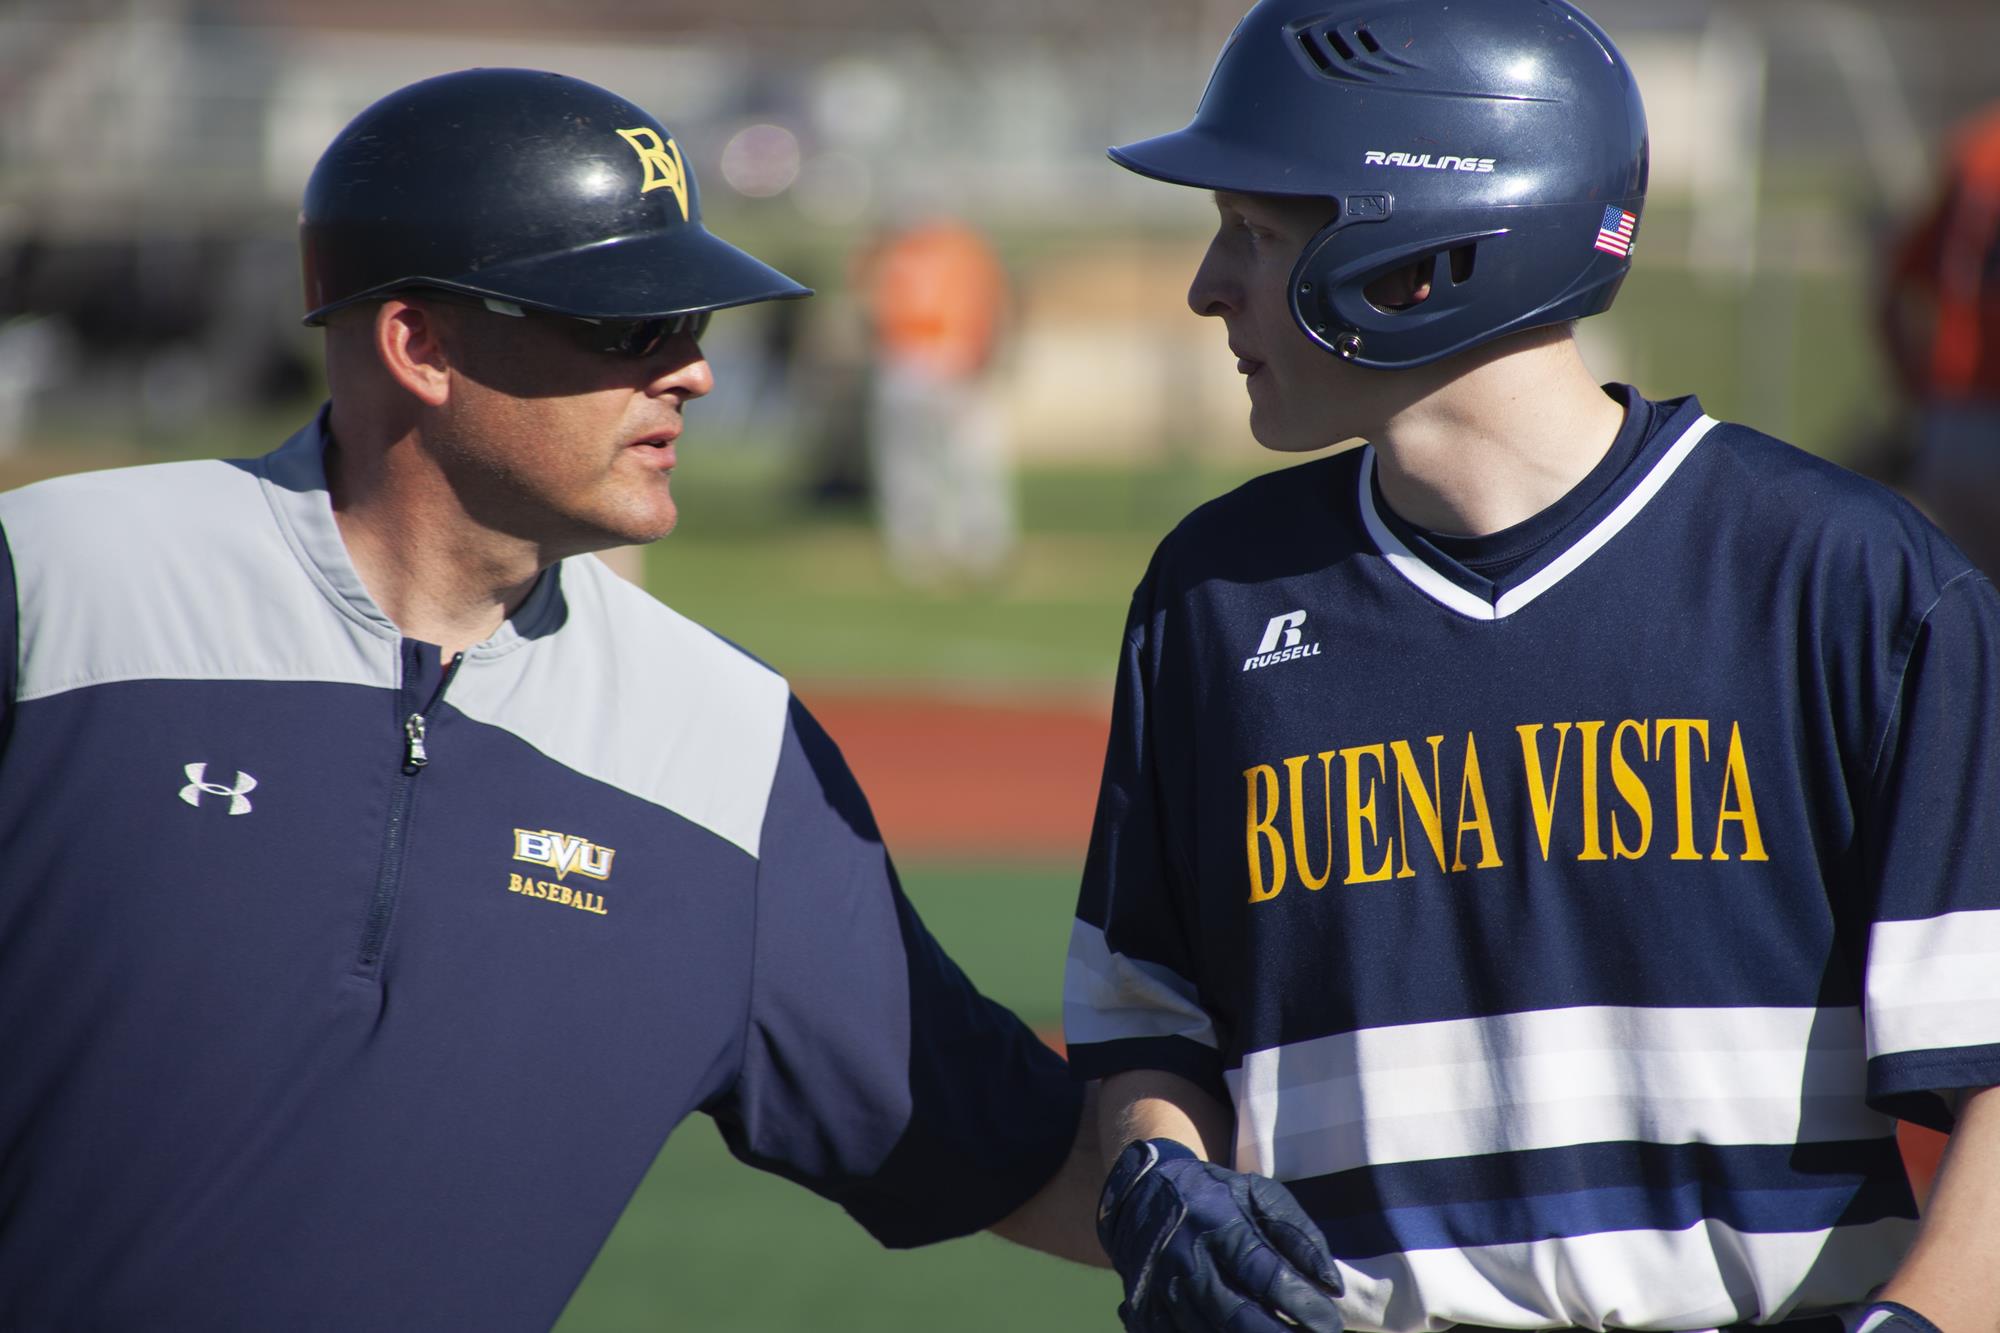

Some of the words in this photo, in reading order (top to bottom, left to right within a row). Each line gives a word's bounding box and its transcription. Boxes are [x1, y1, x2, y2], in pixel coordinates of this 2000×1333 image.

[616, 127, 688, 222] BV
[1365, 151, 1496, 173] RAWLINGS
[1257, 609, 1307, 655] R
[1243, 642, 1322, 671] RUSSELL
[1243, 731, 1503, 904] BUENA
[1516, 718, 1769, 861] VISTA
[513, 828, 616, 881] BVU
[508, 873, 608, 915] BASEBALL
